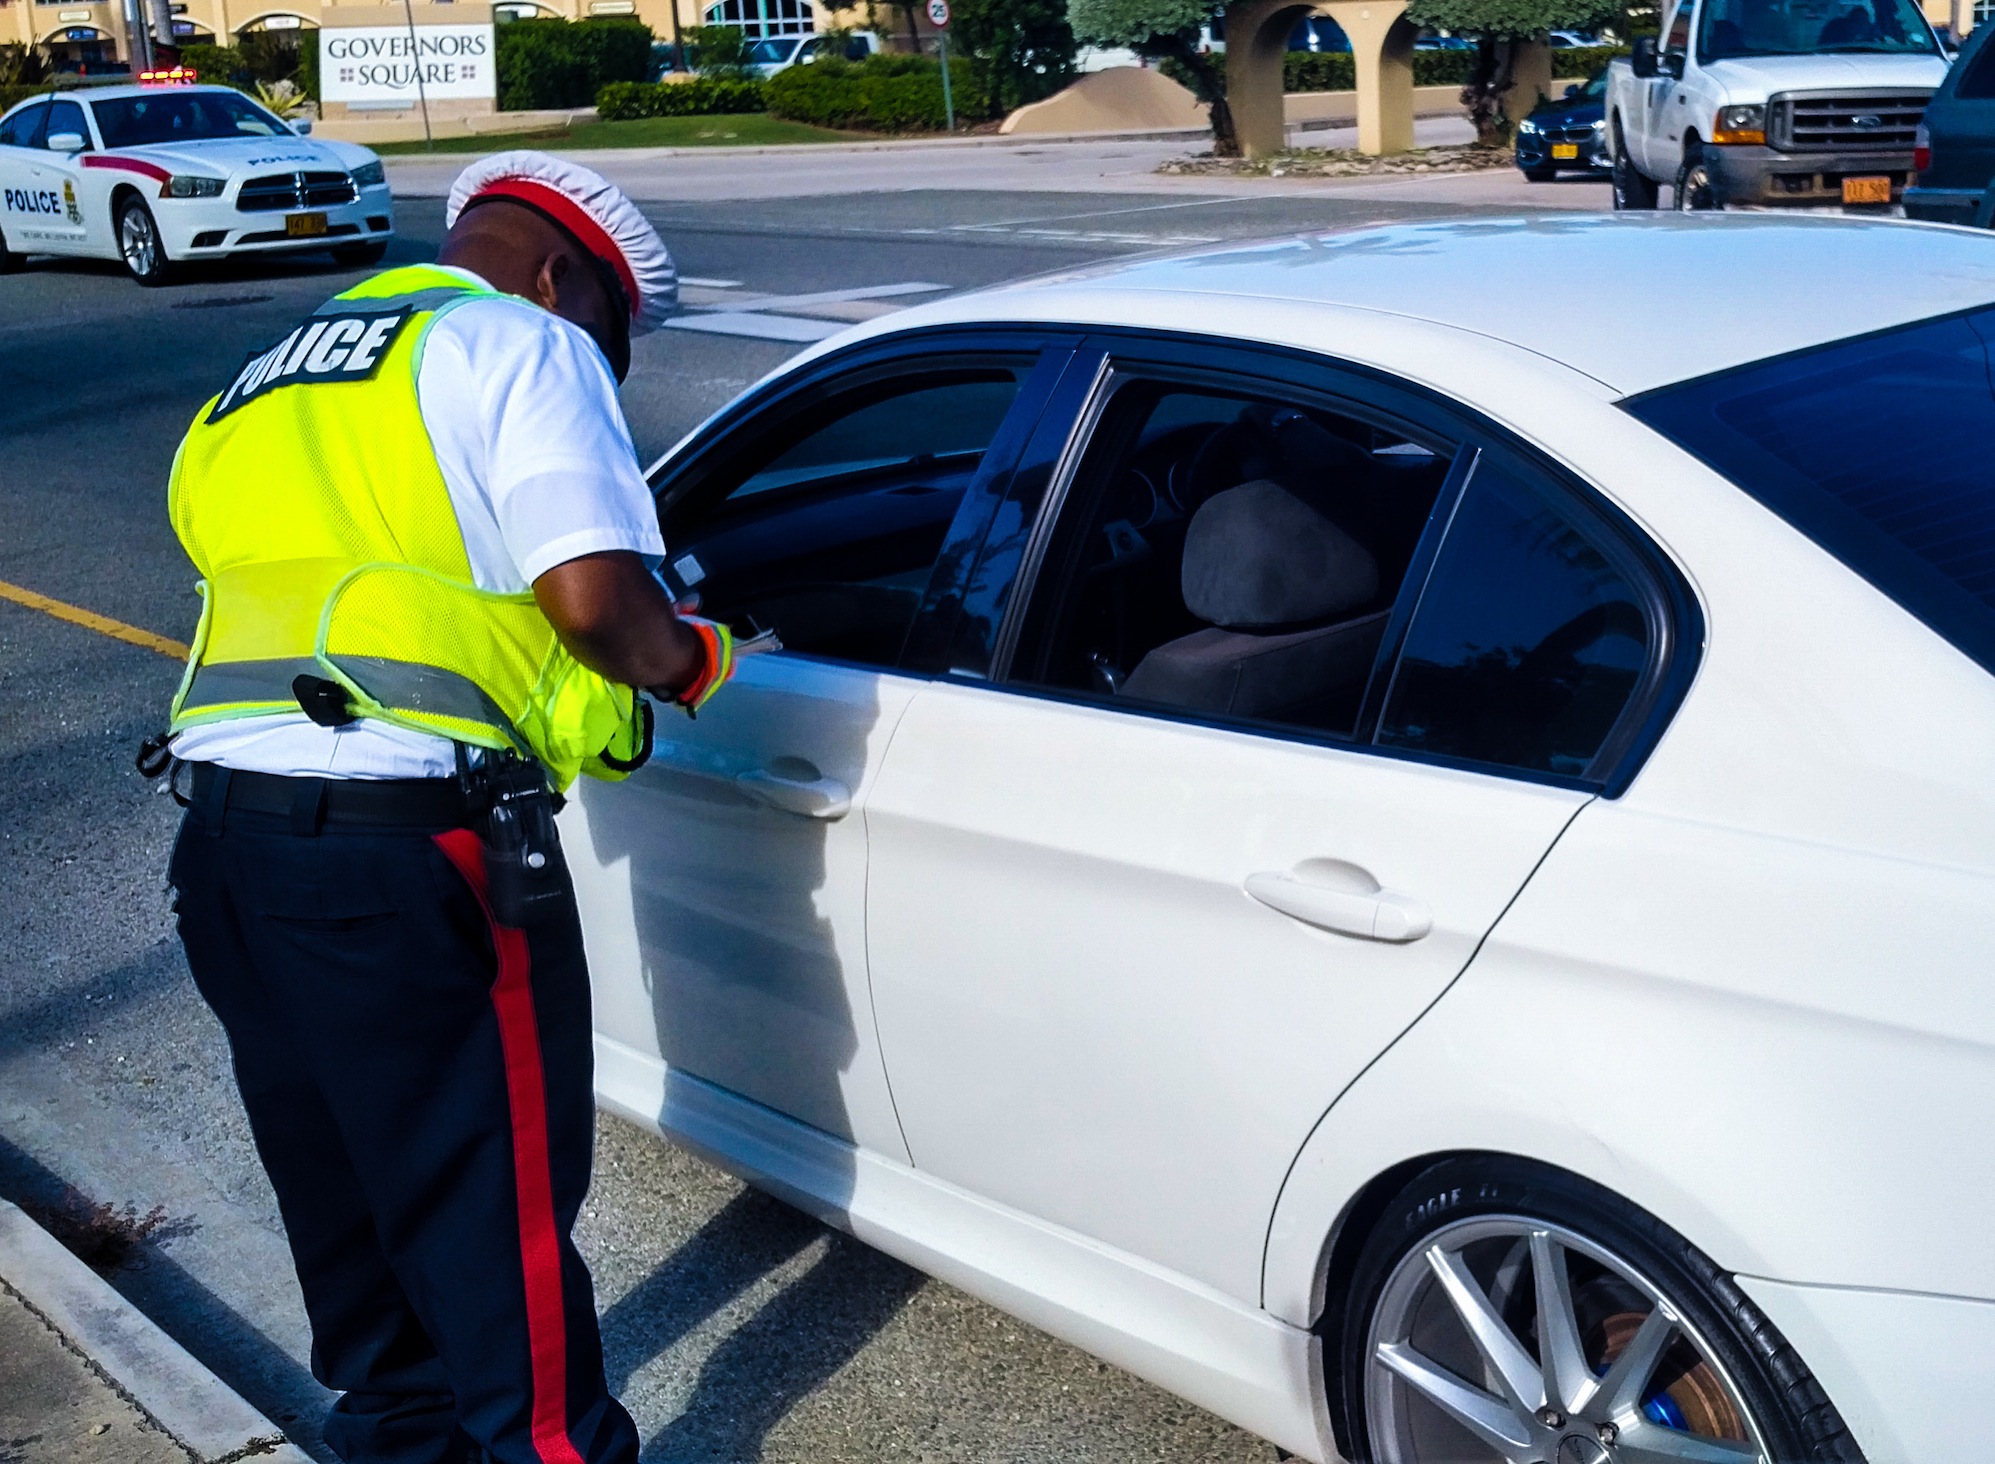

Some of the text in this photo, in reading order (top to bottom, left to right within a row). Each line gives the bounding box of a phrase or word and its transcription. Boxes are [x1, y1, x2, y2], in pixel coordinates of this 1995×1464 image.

[932, 4, 946, 18] 25
[328, 34, 487, 59] GOVERNORS
[358, 63, 456, 90] SQUARE
[4, 188, 62, 214] POLICE
[217, 315, 401, 413] POLICE
